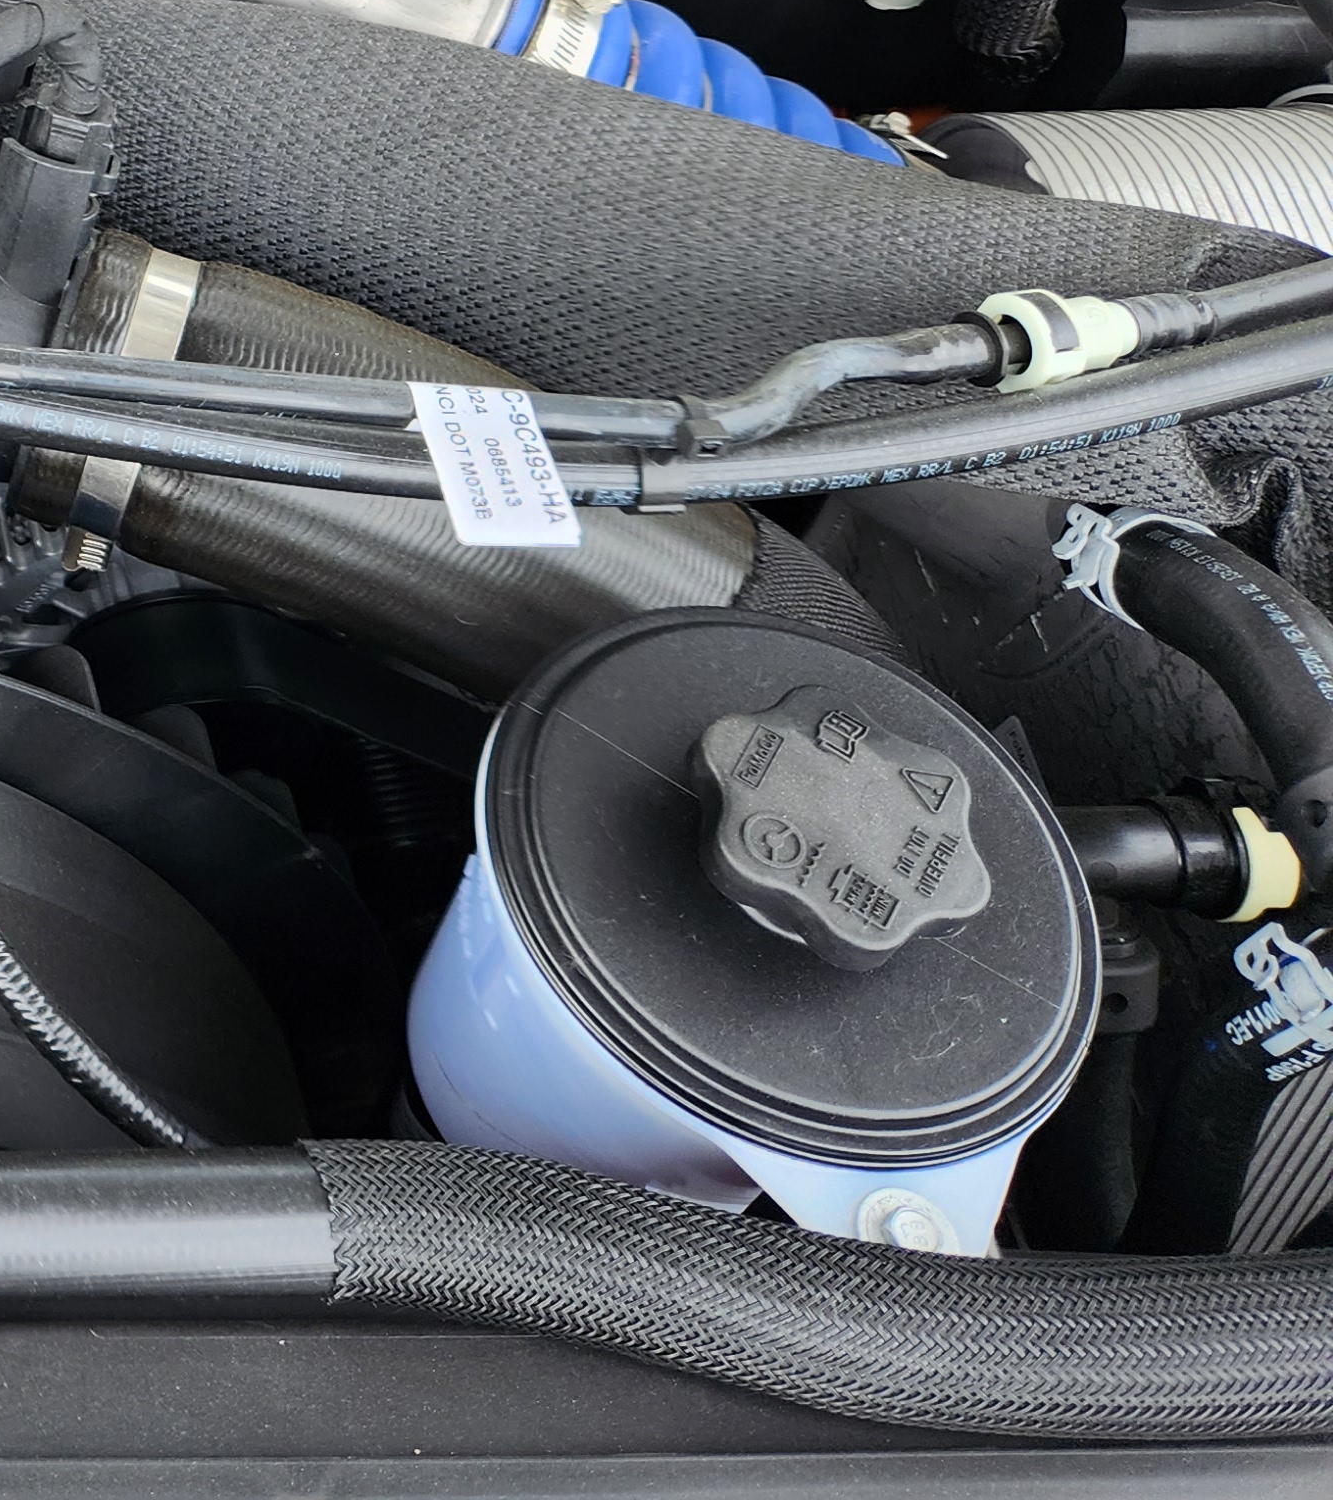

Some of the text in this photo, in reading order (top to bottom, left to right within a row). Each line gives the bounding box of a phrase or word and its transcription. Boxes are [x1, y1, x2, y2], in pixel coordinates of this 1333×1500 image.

[32, 408, 64, 433] MEX
[71, 417, 113, 442] RR/L
[122, 426, 136, 444] C
[140, 430, 162, 450] B2
[171, 434, 243, 465] 01:54:51
[251, 447, 303, 476] K119N
[305, 459, 344, 481] 1000
[434, 386, 494, 520] NCI DOT M073B
[880, 468, 913, 484] MEX
[916, 461, 955, 479] RR/L
[964, 456, 976, 471] C
[982, 451, 1007, 468] B2
[1017, 434, 1093, 462] 01:54:51
[1099, 422, 1144, 444] K119N
[1147, 411, 1182, 432] 1000
[737, 732, 779, 788] FoMoCo
[893, 825, 931, 878] DO NOT
[914, 831, 963, 898] OVERFILL
